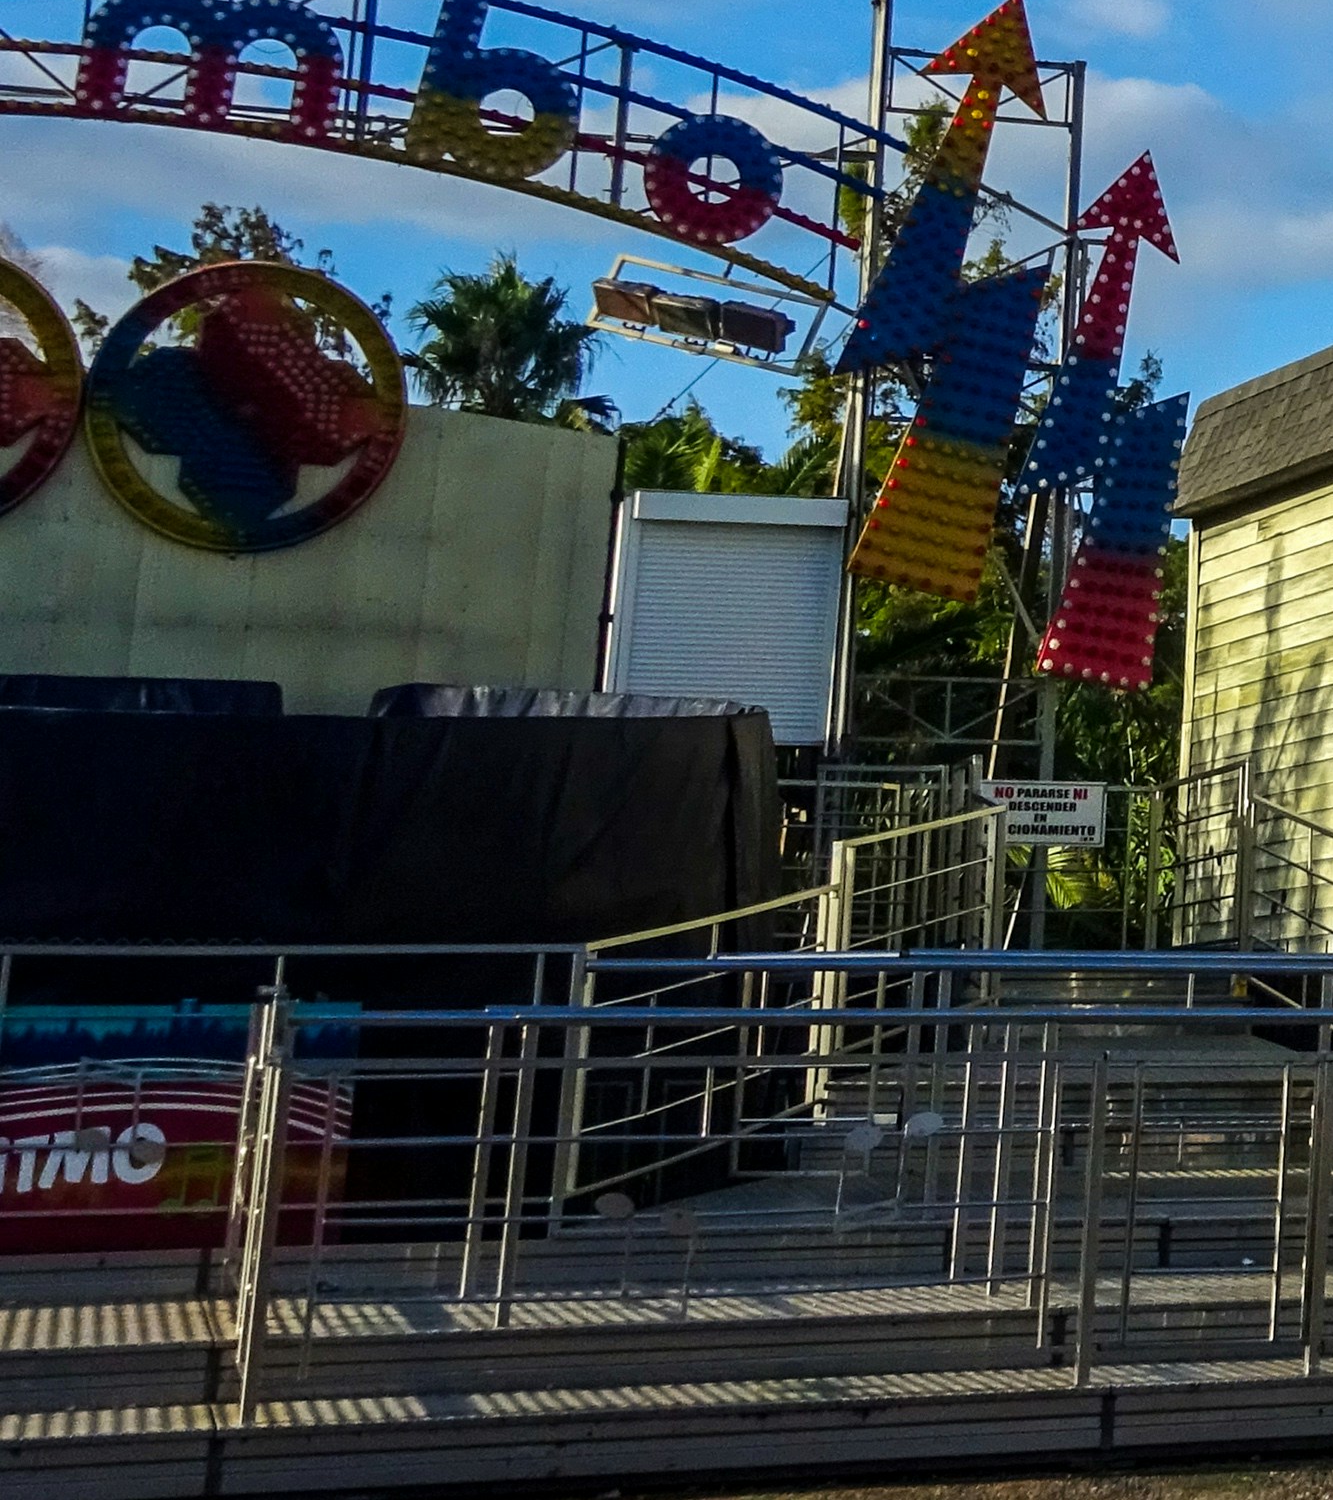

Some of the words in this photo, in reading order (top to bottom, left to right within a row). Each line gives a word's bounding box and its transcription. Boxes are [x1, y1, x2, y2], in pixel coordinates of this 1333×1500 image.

[994, 786, 1014, 798] NO
[1017, 788, 1070, 798] PARARSE
[1073, 788, 1089, 800] NI
[1008, 802, 1077, 812] DESCENDER
[1034, 814, 1047, 823] EN
